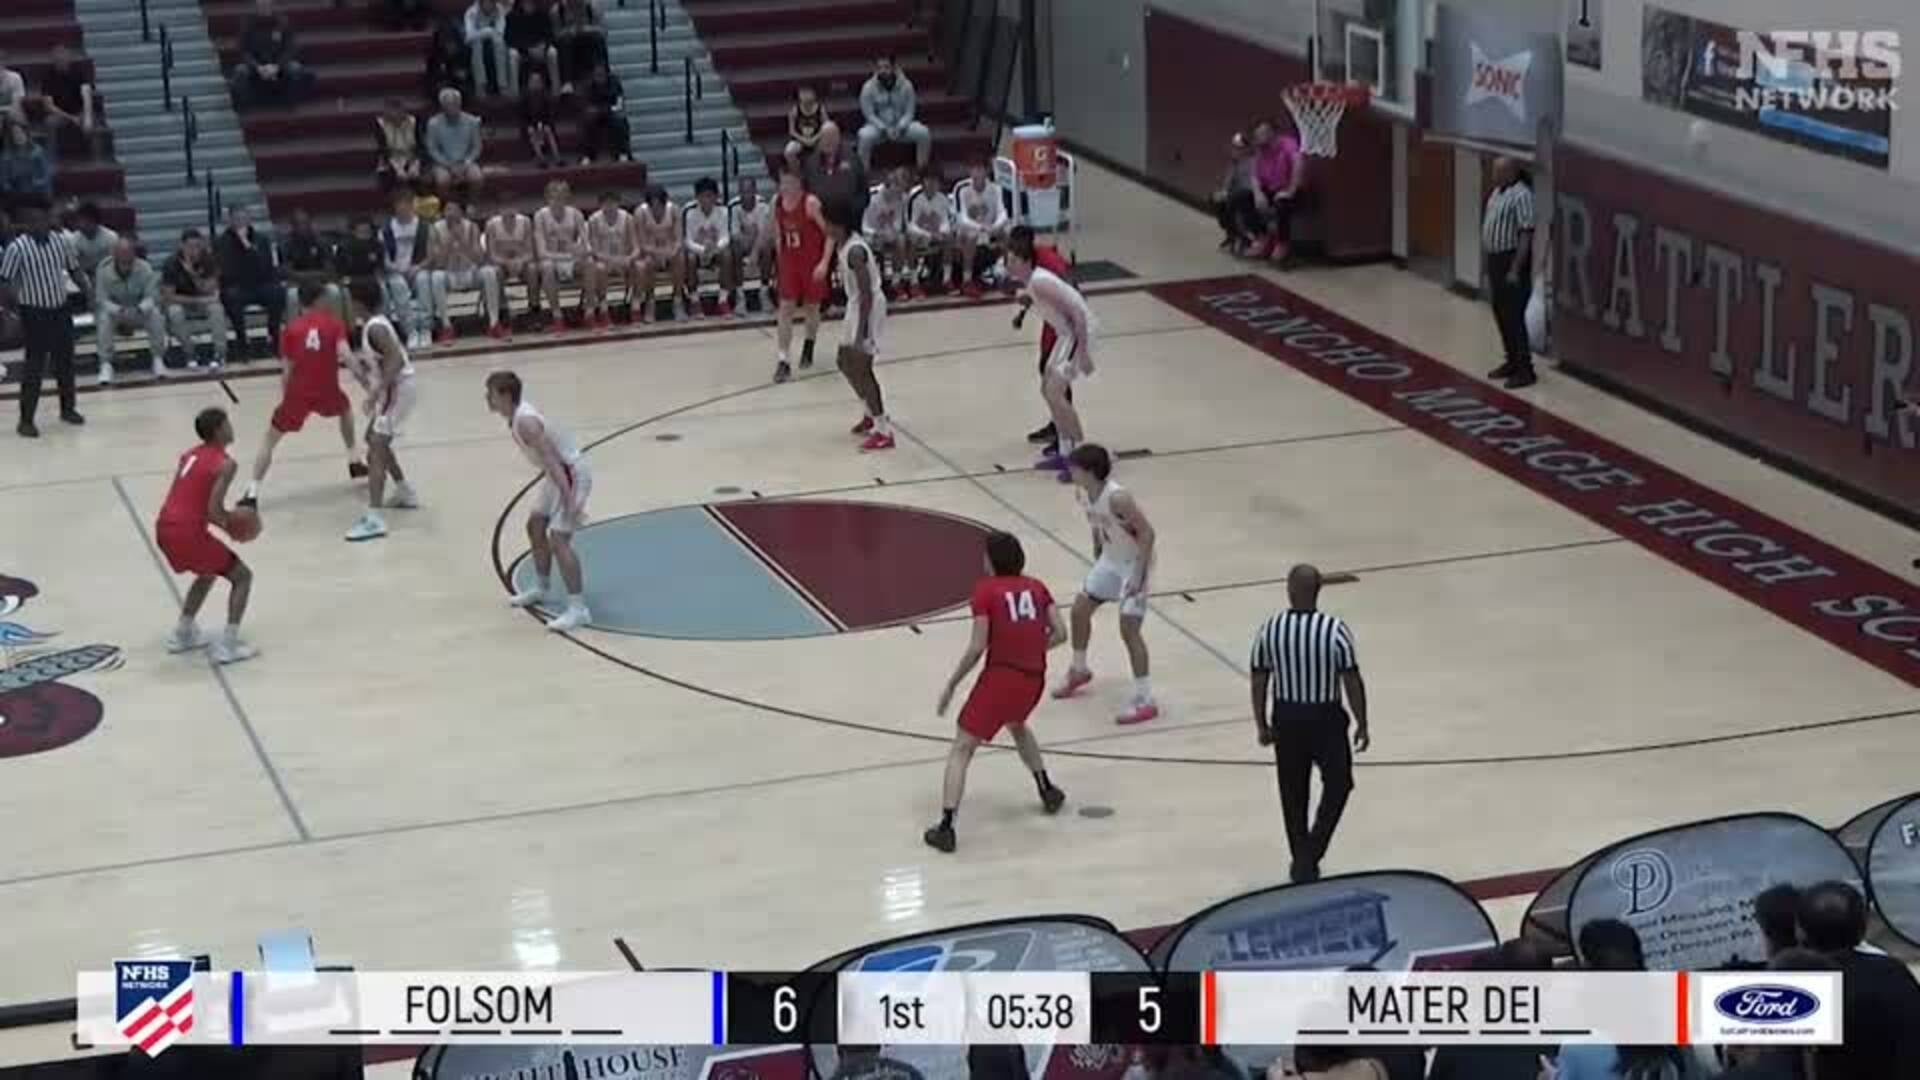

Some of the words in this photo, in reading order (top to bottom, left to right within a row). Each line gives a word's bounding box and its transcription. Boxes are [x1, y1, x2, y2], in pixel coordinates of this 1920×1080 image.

[1475, 63, 1521, 99] SONIC
[305, 327, 321, 352] 4
[1203, 290, 1412, 380] RANCHO
[1392, 387, 1644, 491] MIRAGE
[1616, 498, 1837, 584] HIGH
[1810, 594, 1920, 660] SC
[1005, 589, 1037, 622] 14
